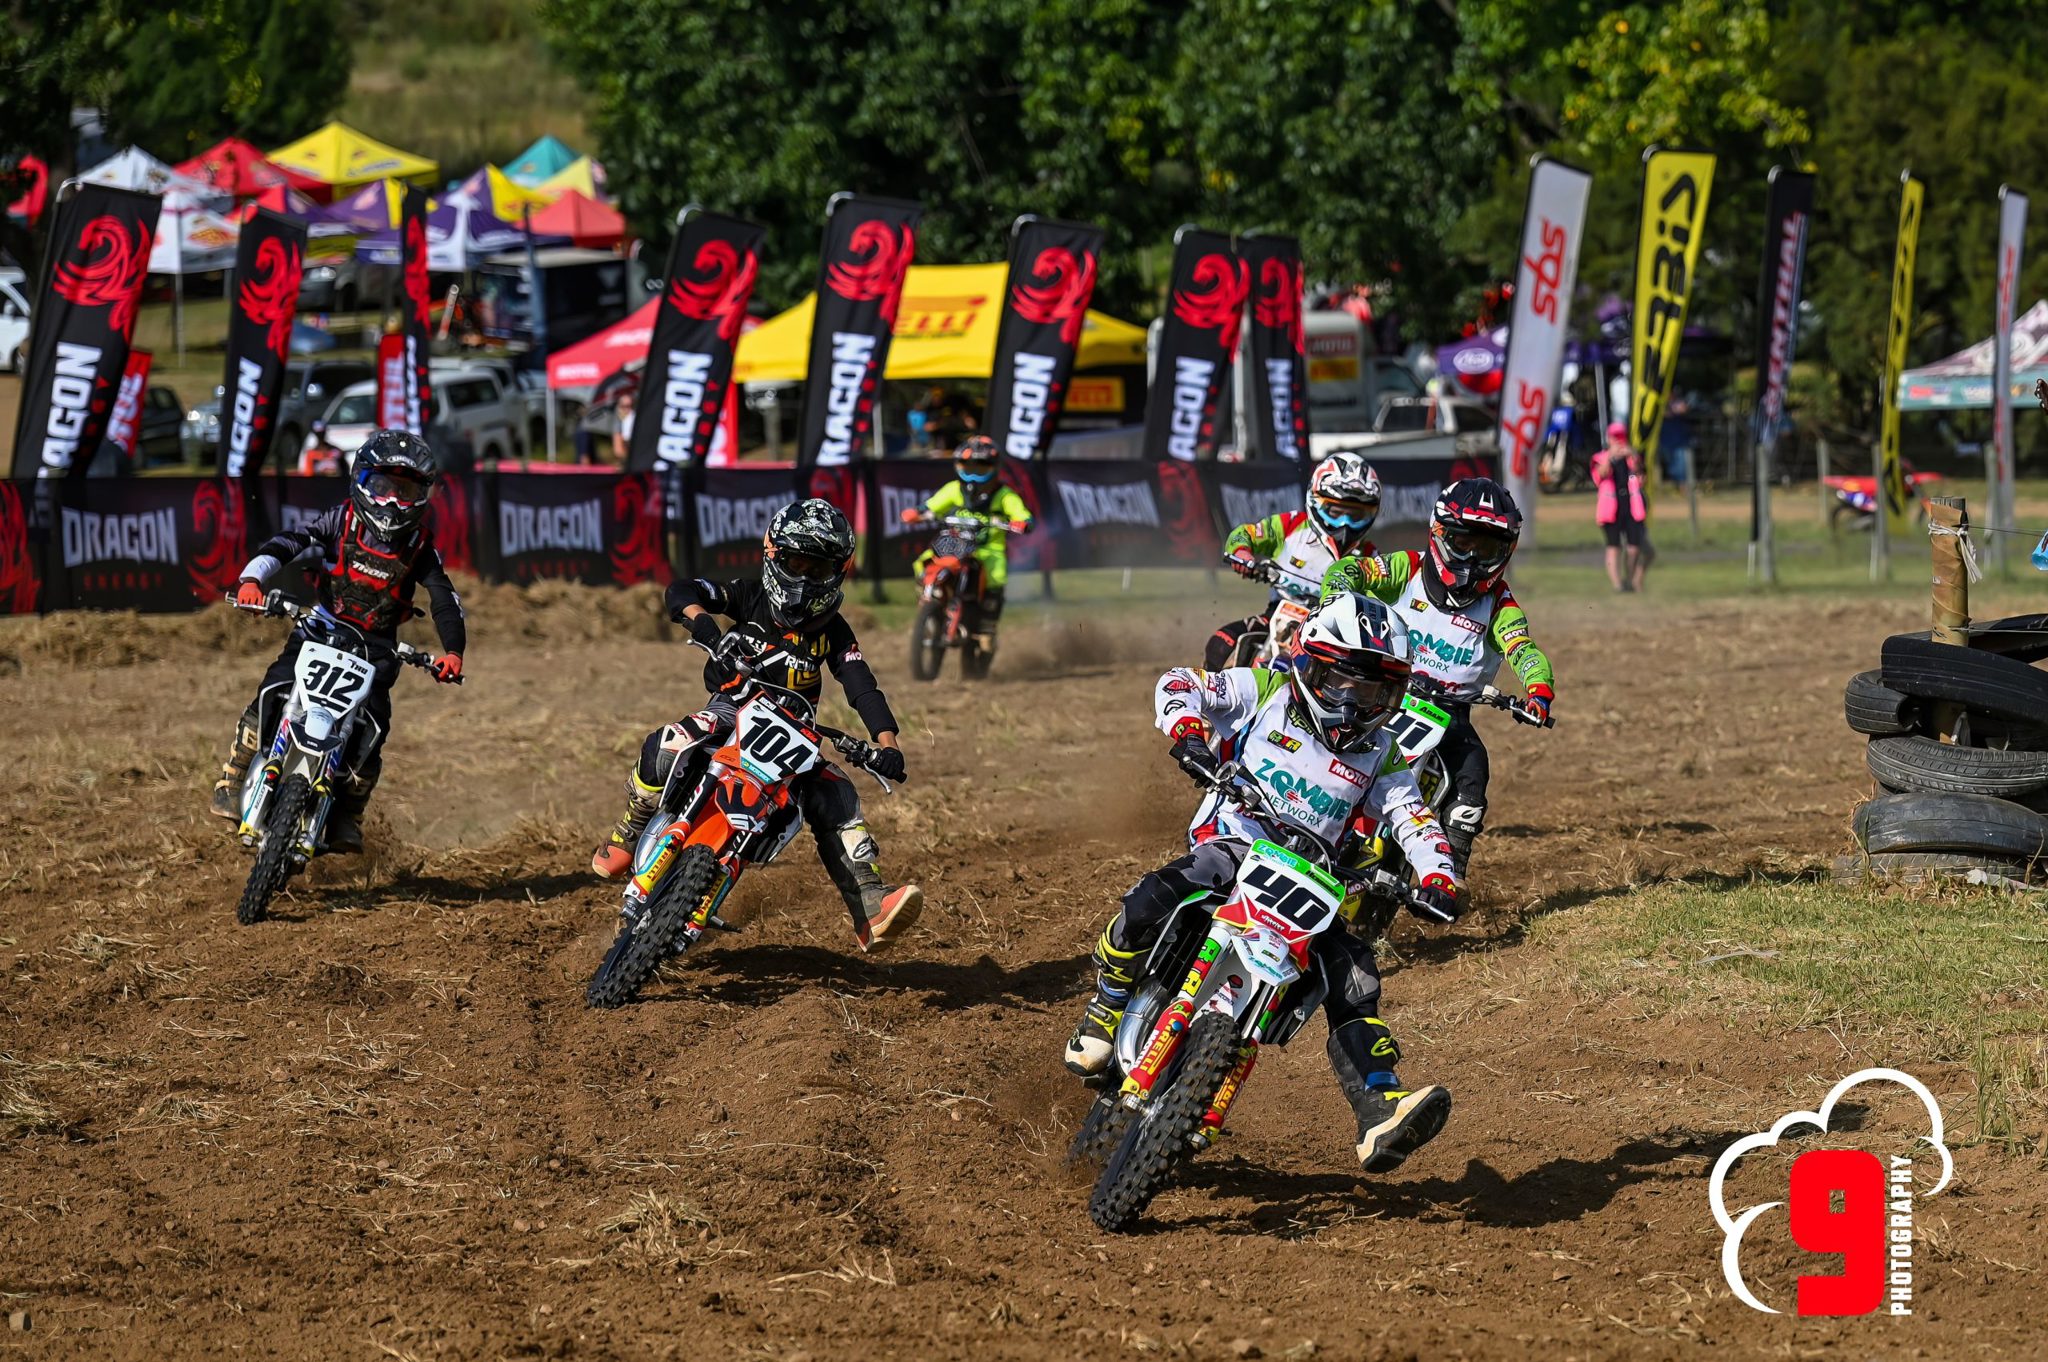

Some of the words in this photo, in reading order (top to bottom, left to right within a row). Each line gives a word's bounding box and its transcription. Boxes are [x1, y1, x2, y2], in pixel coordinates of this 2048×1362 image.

[41, 341, 103, 468] AGON
[227, 356, 263, 476] AGON
[657, 349, 712, 464] AGON
[815, 331, 876, 466] RAGON
[1005, 352, 1057, 460] AGON
[1167, 355, 1215, 461] AGON
[61, 506, 179, 568] DRAGON
[500, 497, 602, 557] DRAGON
[351, 560, 390, 580] THOR
[1409, 629, 1474, 667] OMBIE
[1453, 616, 1485, 633] MOTU
[303, 659, 365, 705] 312
[1414, 653, 1450, 673] TWORX
[740, 716, 813, 778] 104
[1332, 762, 1369, 787] MOTU
[1254, 758, 1352, 822] ZOMBIE
[1263, 791, 1324, 829] NETWORX
[1242, 864, 1330, 931] 40
